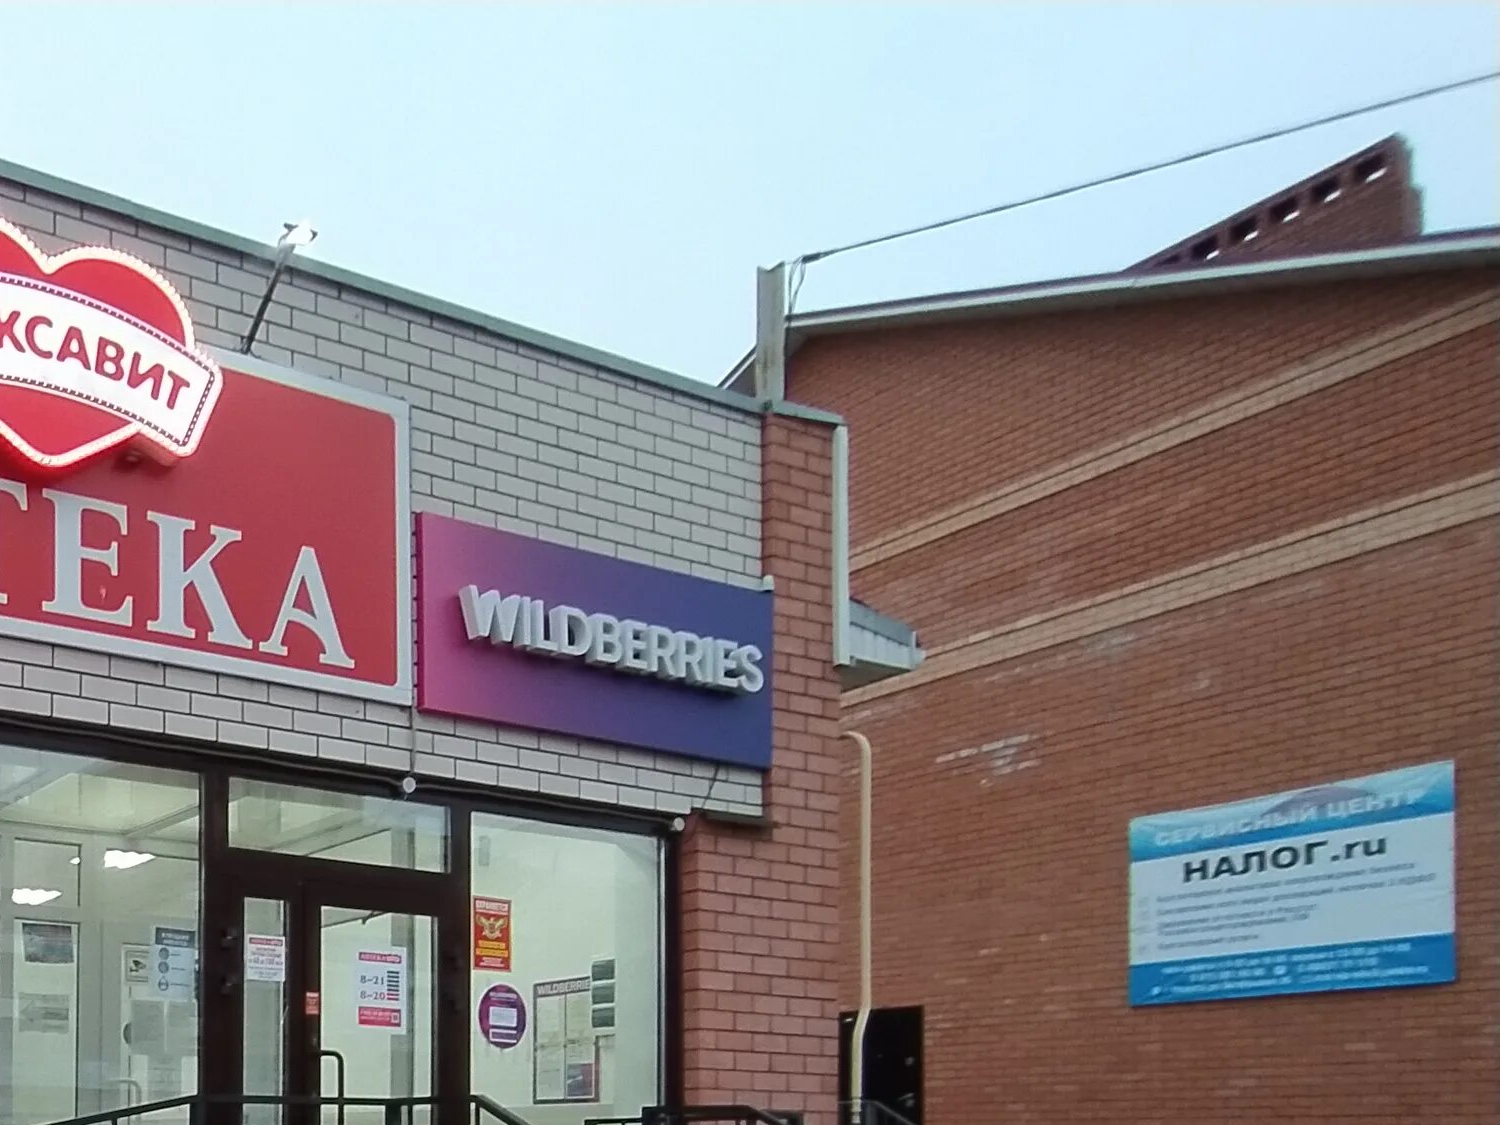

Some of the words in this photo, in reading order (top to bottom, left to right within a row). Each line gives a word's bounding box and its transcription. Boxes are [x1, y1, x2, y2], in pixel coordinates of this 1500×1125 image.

[458, 584, 764, 692] WILDBERRIES
[1181, 836, 1388, 884] НАЛОГ.ru
[536, 979, 591, 995] WILDBERRIE
